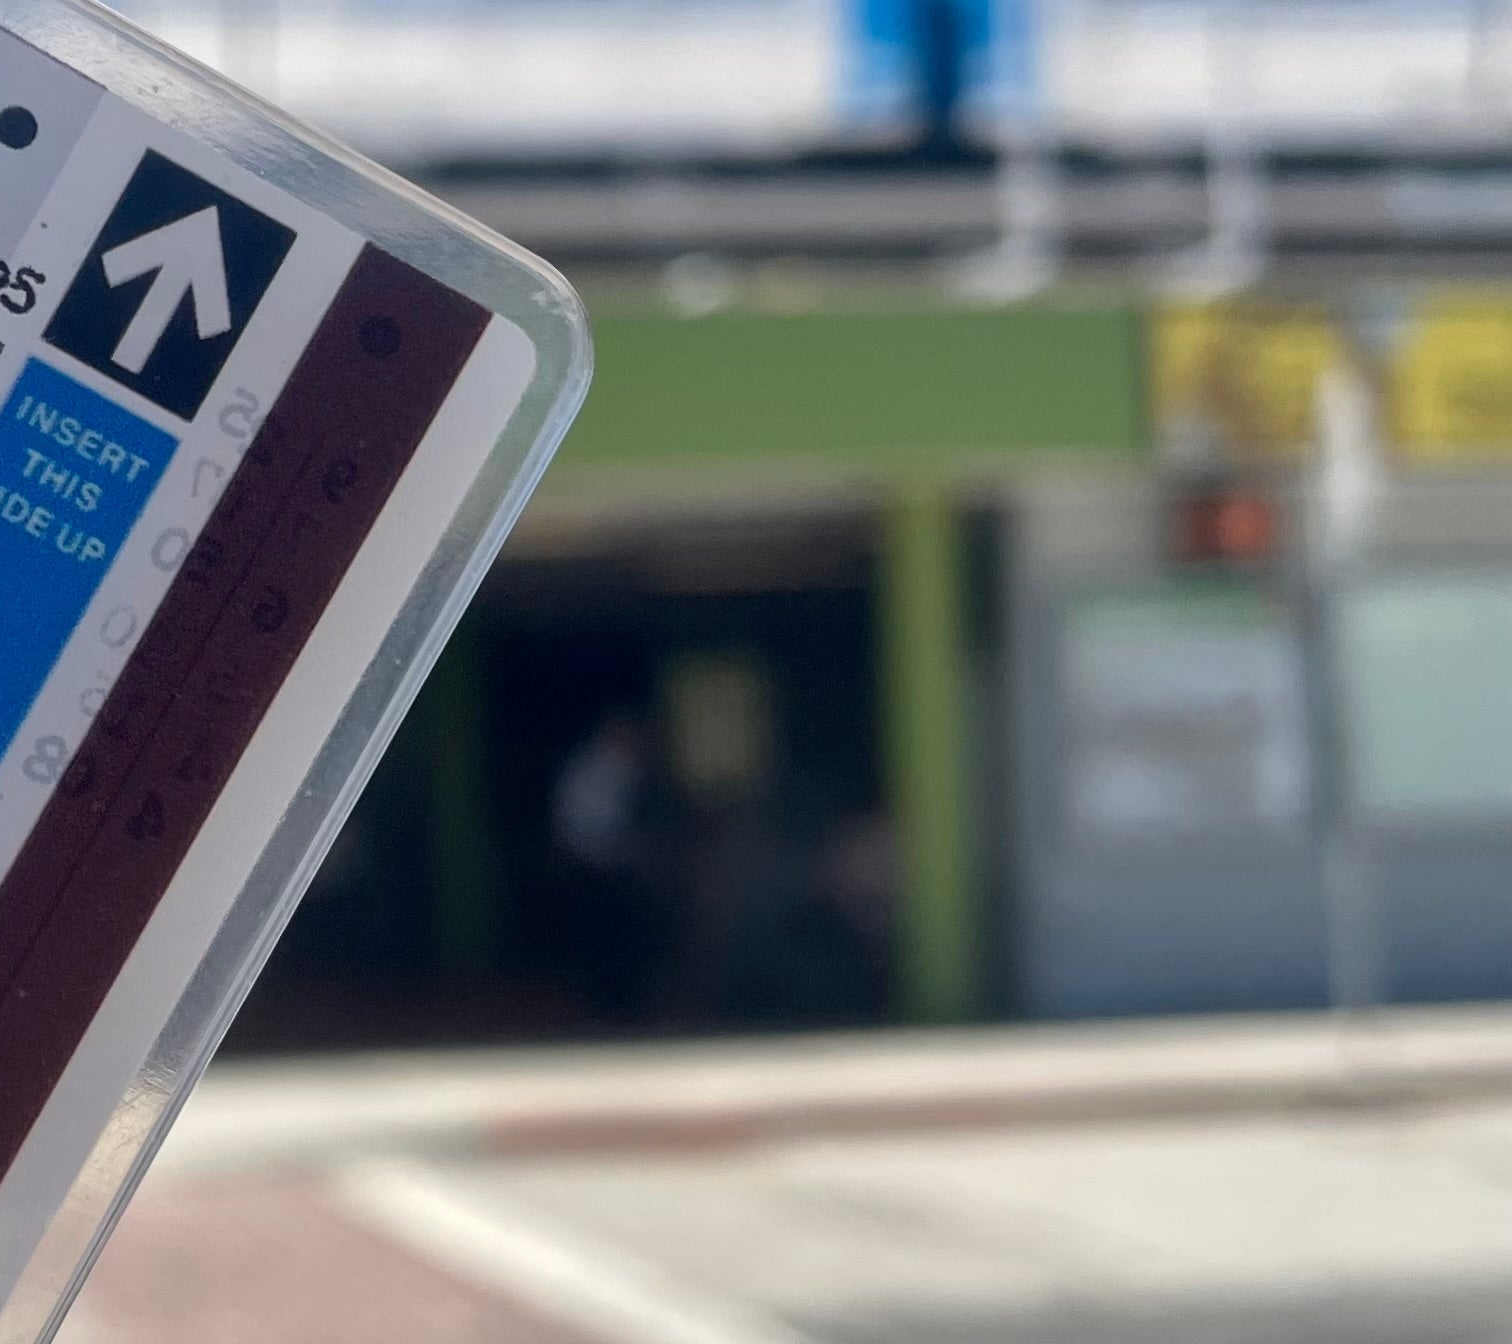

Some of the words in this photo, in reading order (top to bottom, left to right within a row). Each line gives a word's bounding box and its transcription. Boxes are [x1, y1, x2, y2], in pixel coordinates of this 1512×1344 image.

[16, 396, 150, 482] INSERT
[23, 448, 104, 512] THIS
[55, 529, 106, 562] UP
